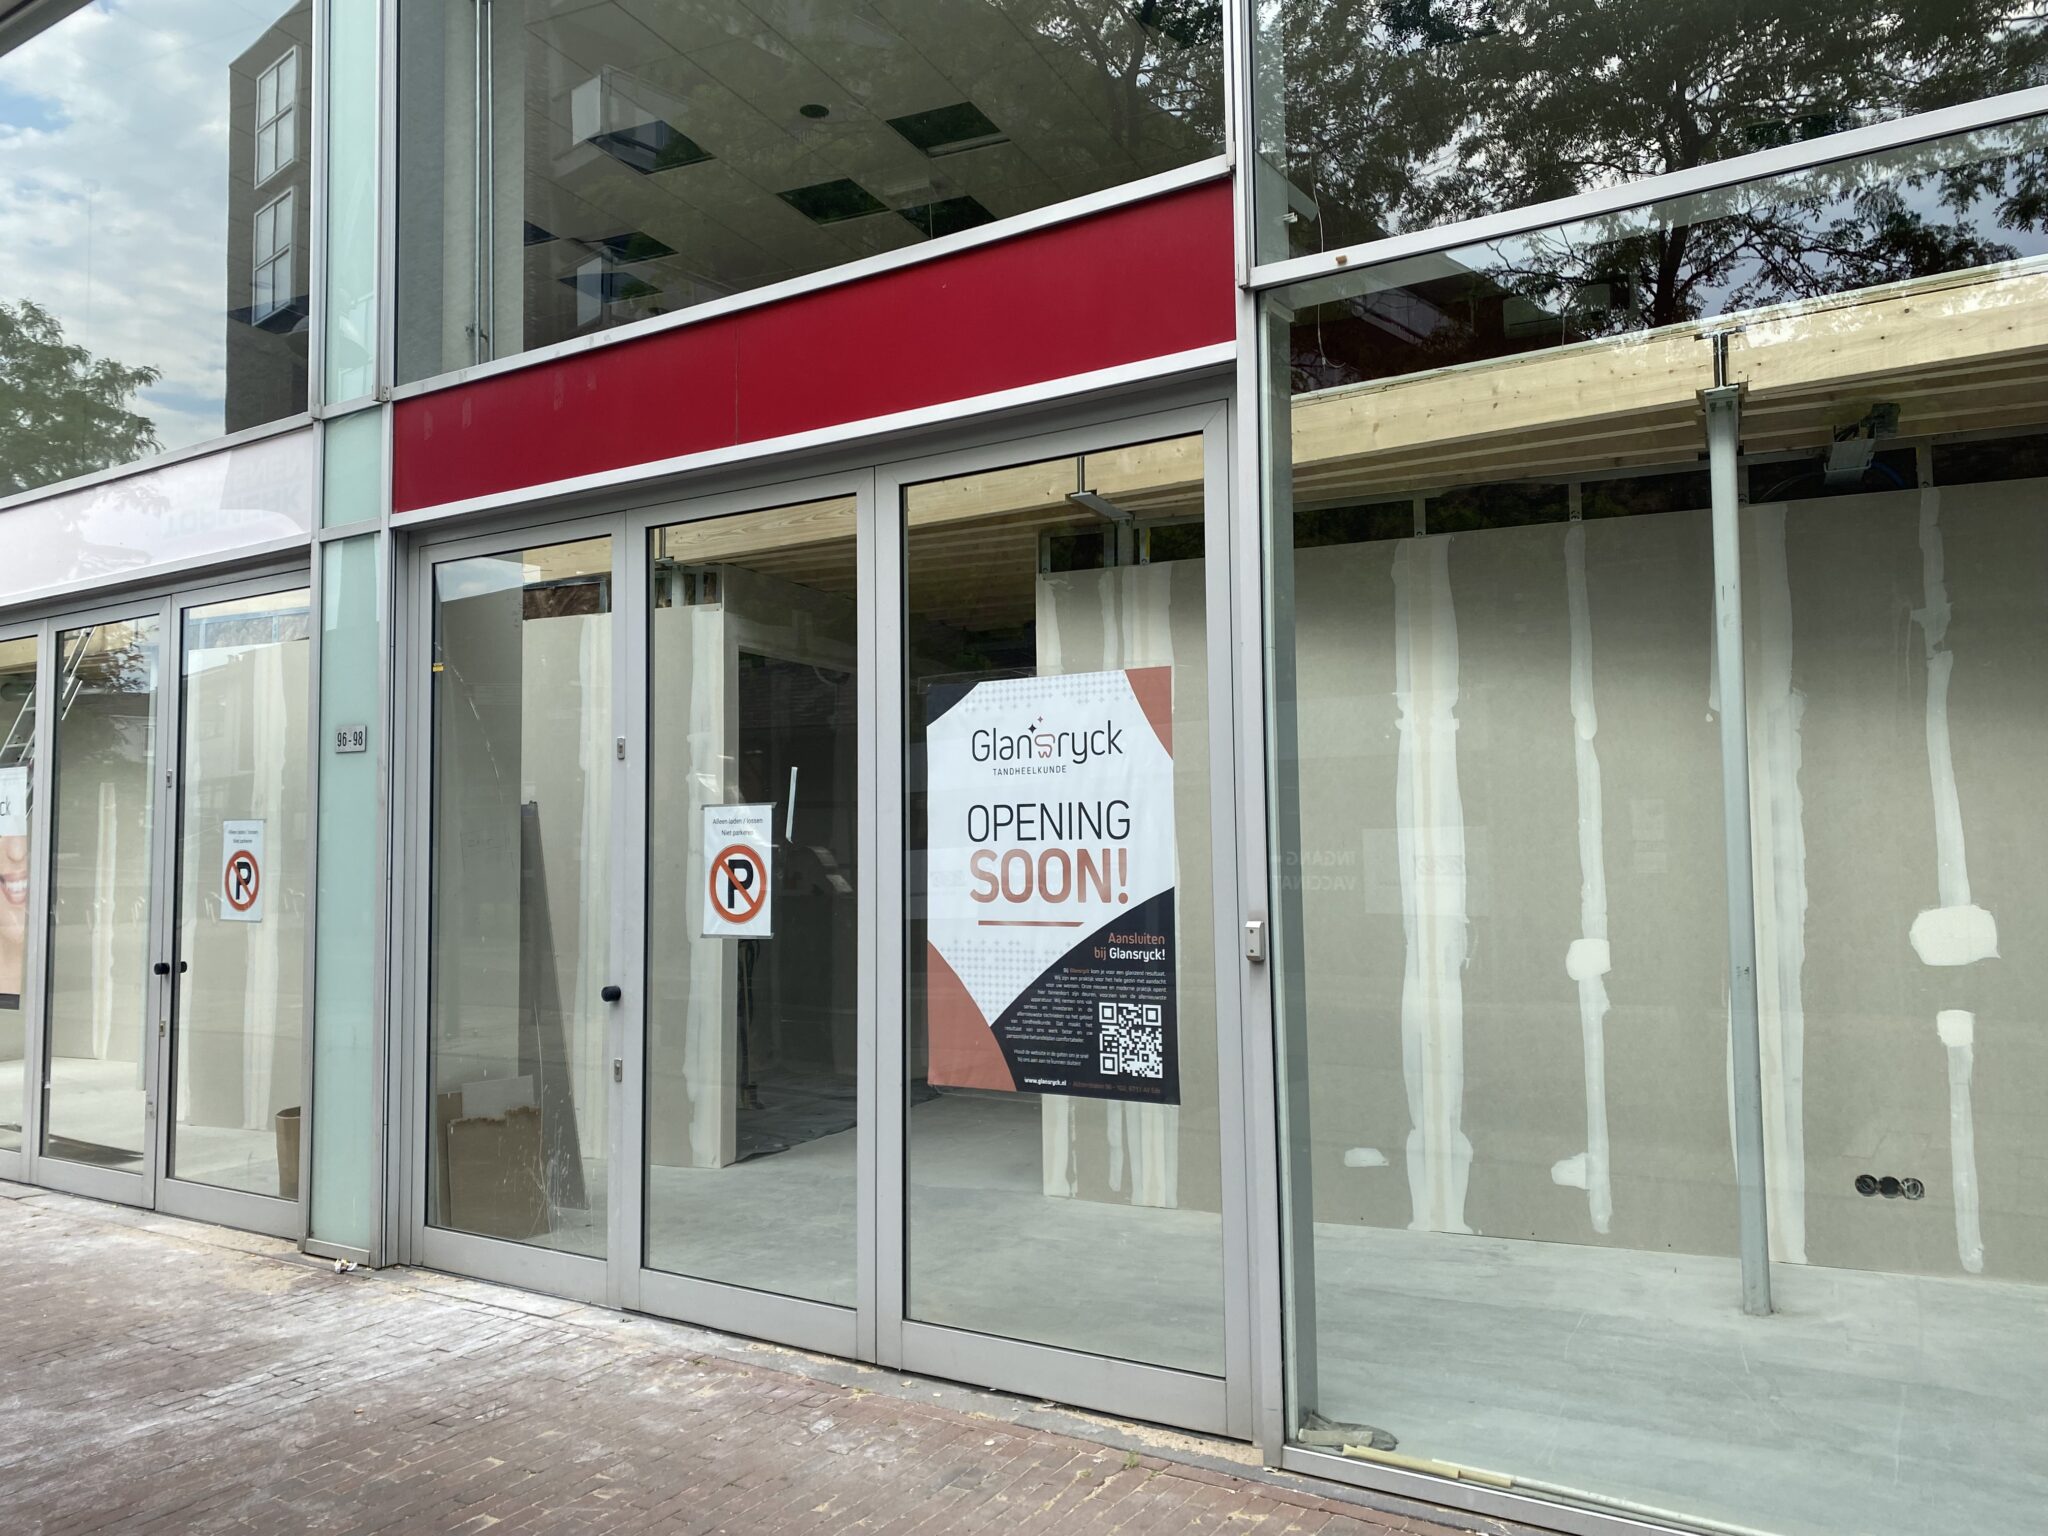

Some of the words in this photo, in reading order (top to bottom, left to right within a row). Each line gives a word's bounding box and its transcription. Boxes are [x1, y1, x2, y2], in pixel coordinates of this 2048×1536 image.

[971, 720, 1124, 765] Glansryck
[992, 765, 1067, 777] TANDHEELKUNDE
[967, 800, 1131, 843] OPENING
[969, 848, 1129, 905] SOON!
[1108, 932, 1166, 945] Aansluiten
[1094, 946, 1107, 961] bij
[1109, 947, 1166, 963] Glansryck!
